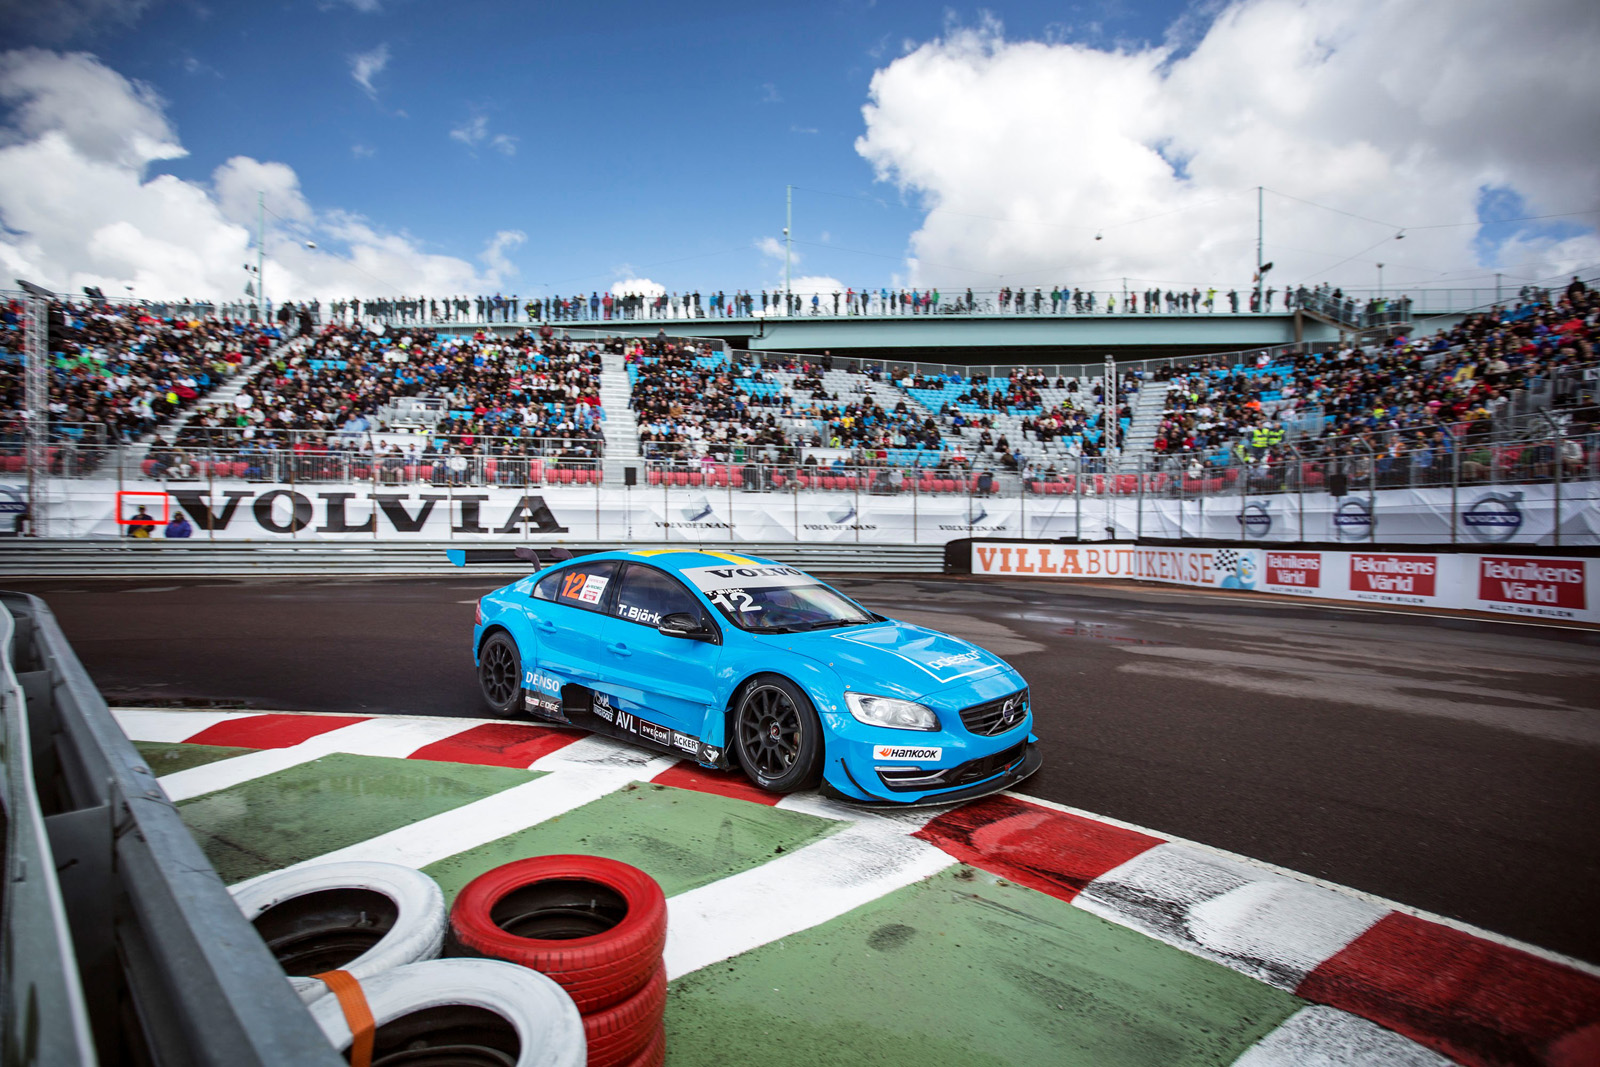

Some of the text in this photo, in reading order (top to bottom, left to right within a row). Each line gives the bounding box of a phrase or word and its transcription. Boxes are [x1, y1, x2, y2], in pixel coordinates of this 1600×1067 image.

[165, 489, 569, 534] VOLVIA
[1465, 515, 1520, 523] VOLVO
[976, 546, 1215, 584] VILLABUTIKEN.SE
[1267, 554, 1320, 570] Teknikens
[1352, 556, 1435, 575] Teknikens
[1481, 560, 1583, 584] Teknikens
[705, 568, 801, 578] VOLVO
[1276, 569, 1306, 584] Värld
[1367, 573, 1414, 592] Värld
[562, 572, 587, 600] 12
[1501, 581, 1558, 603] Värld
[711, 592, 762, 613] 12
[525, 671, 560, 692] DENSO
[540, 700, 560, 713] EDGE
[616, 711, 637, 734] AVL
[642, 725, 667, 740] SWECON
